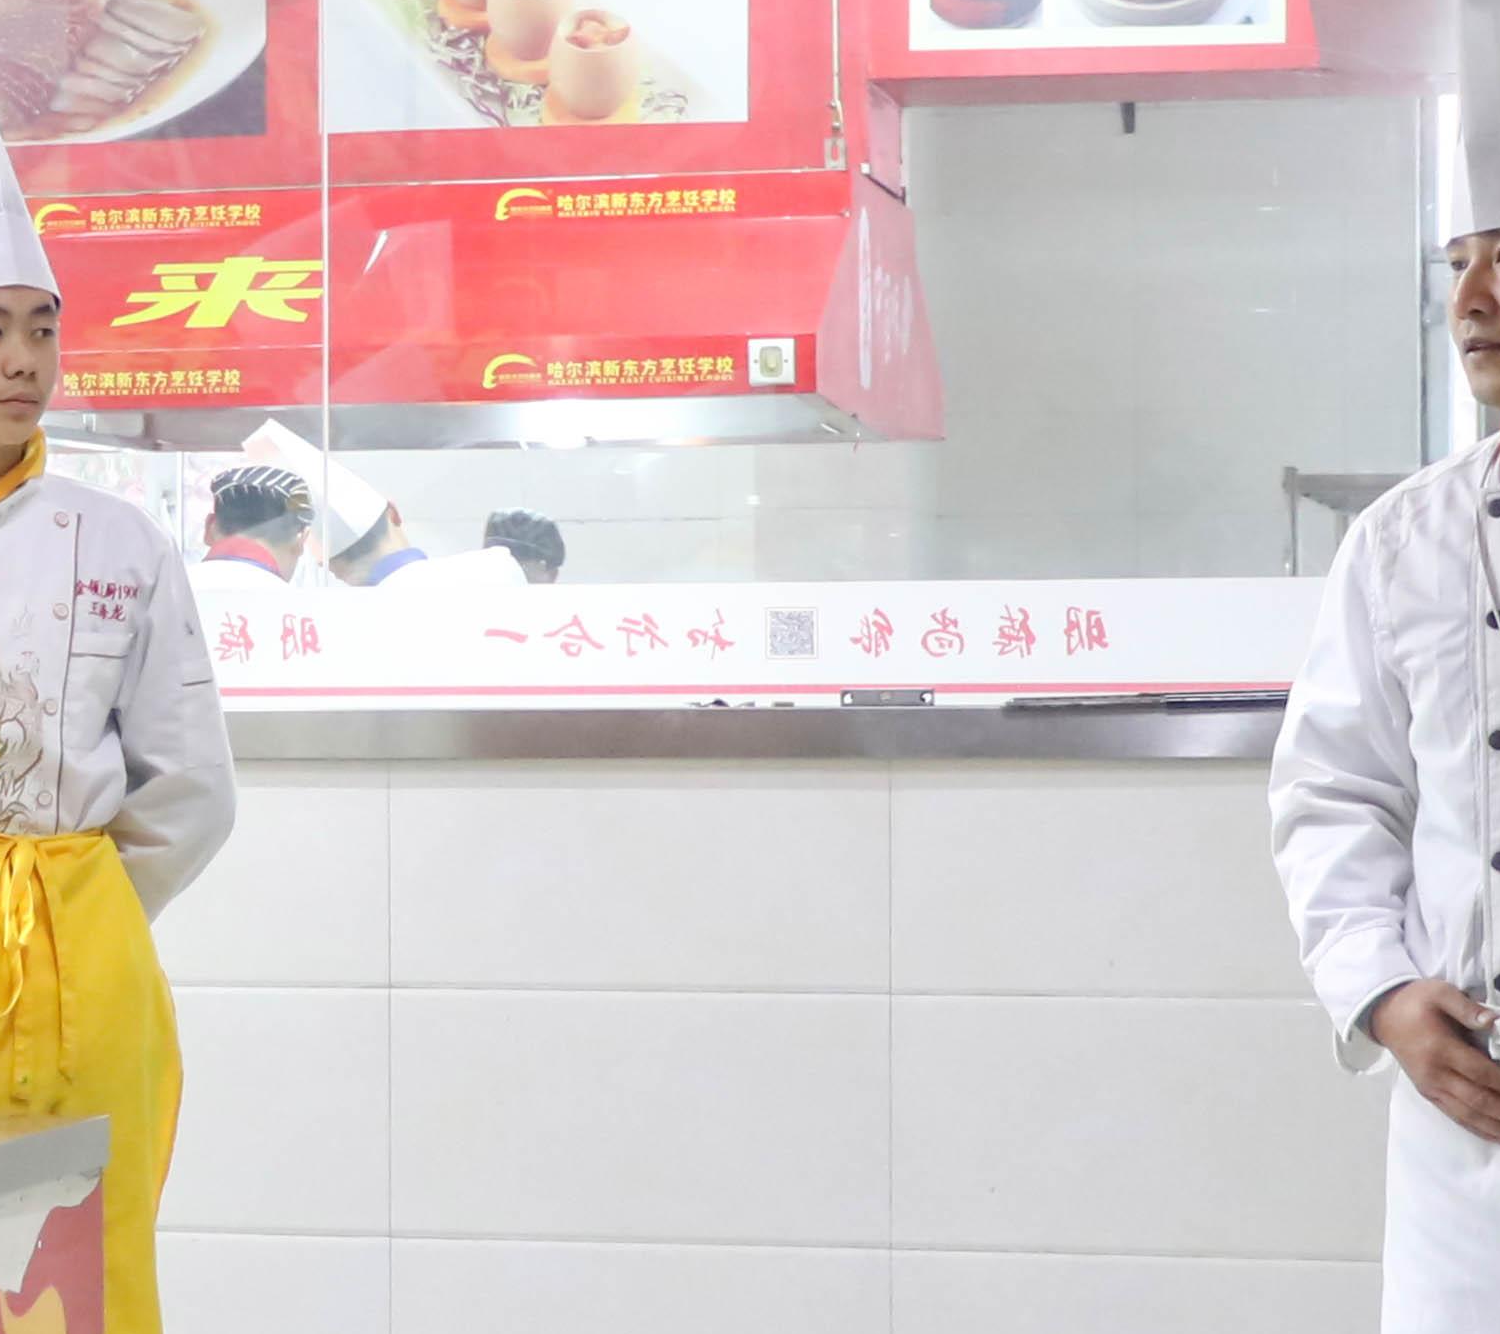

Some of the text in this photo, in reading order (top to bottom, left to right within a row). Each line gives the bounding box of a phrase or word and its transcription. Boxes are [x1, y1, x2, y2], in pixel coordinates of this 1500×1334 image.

[557, 189, 736, 211] 哈尔滨新东方烹饪学校
[90, 204, 261, 224] 哈尔滨新东方烹饪学校
[547, 356, 733, 378] 哈尔滨新东方烹饪学校
[63, 370, 240, 389] 哈尔滨新东方烹饪学校
